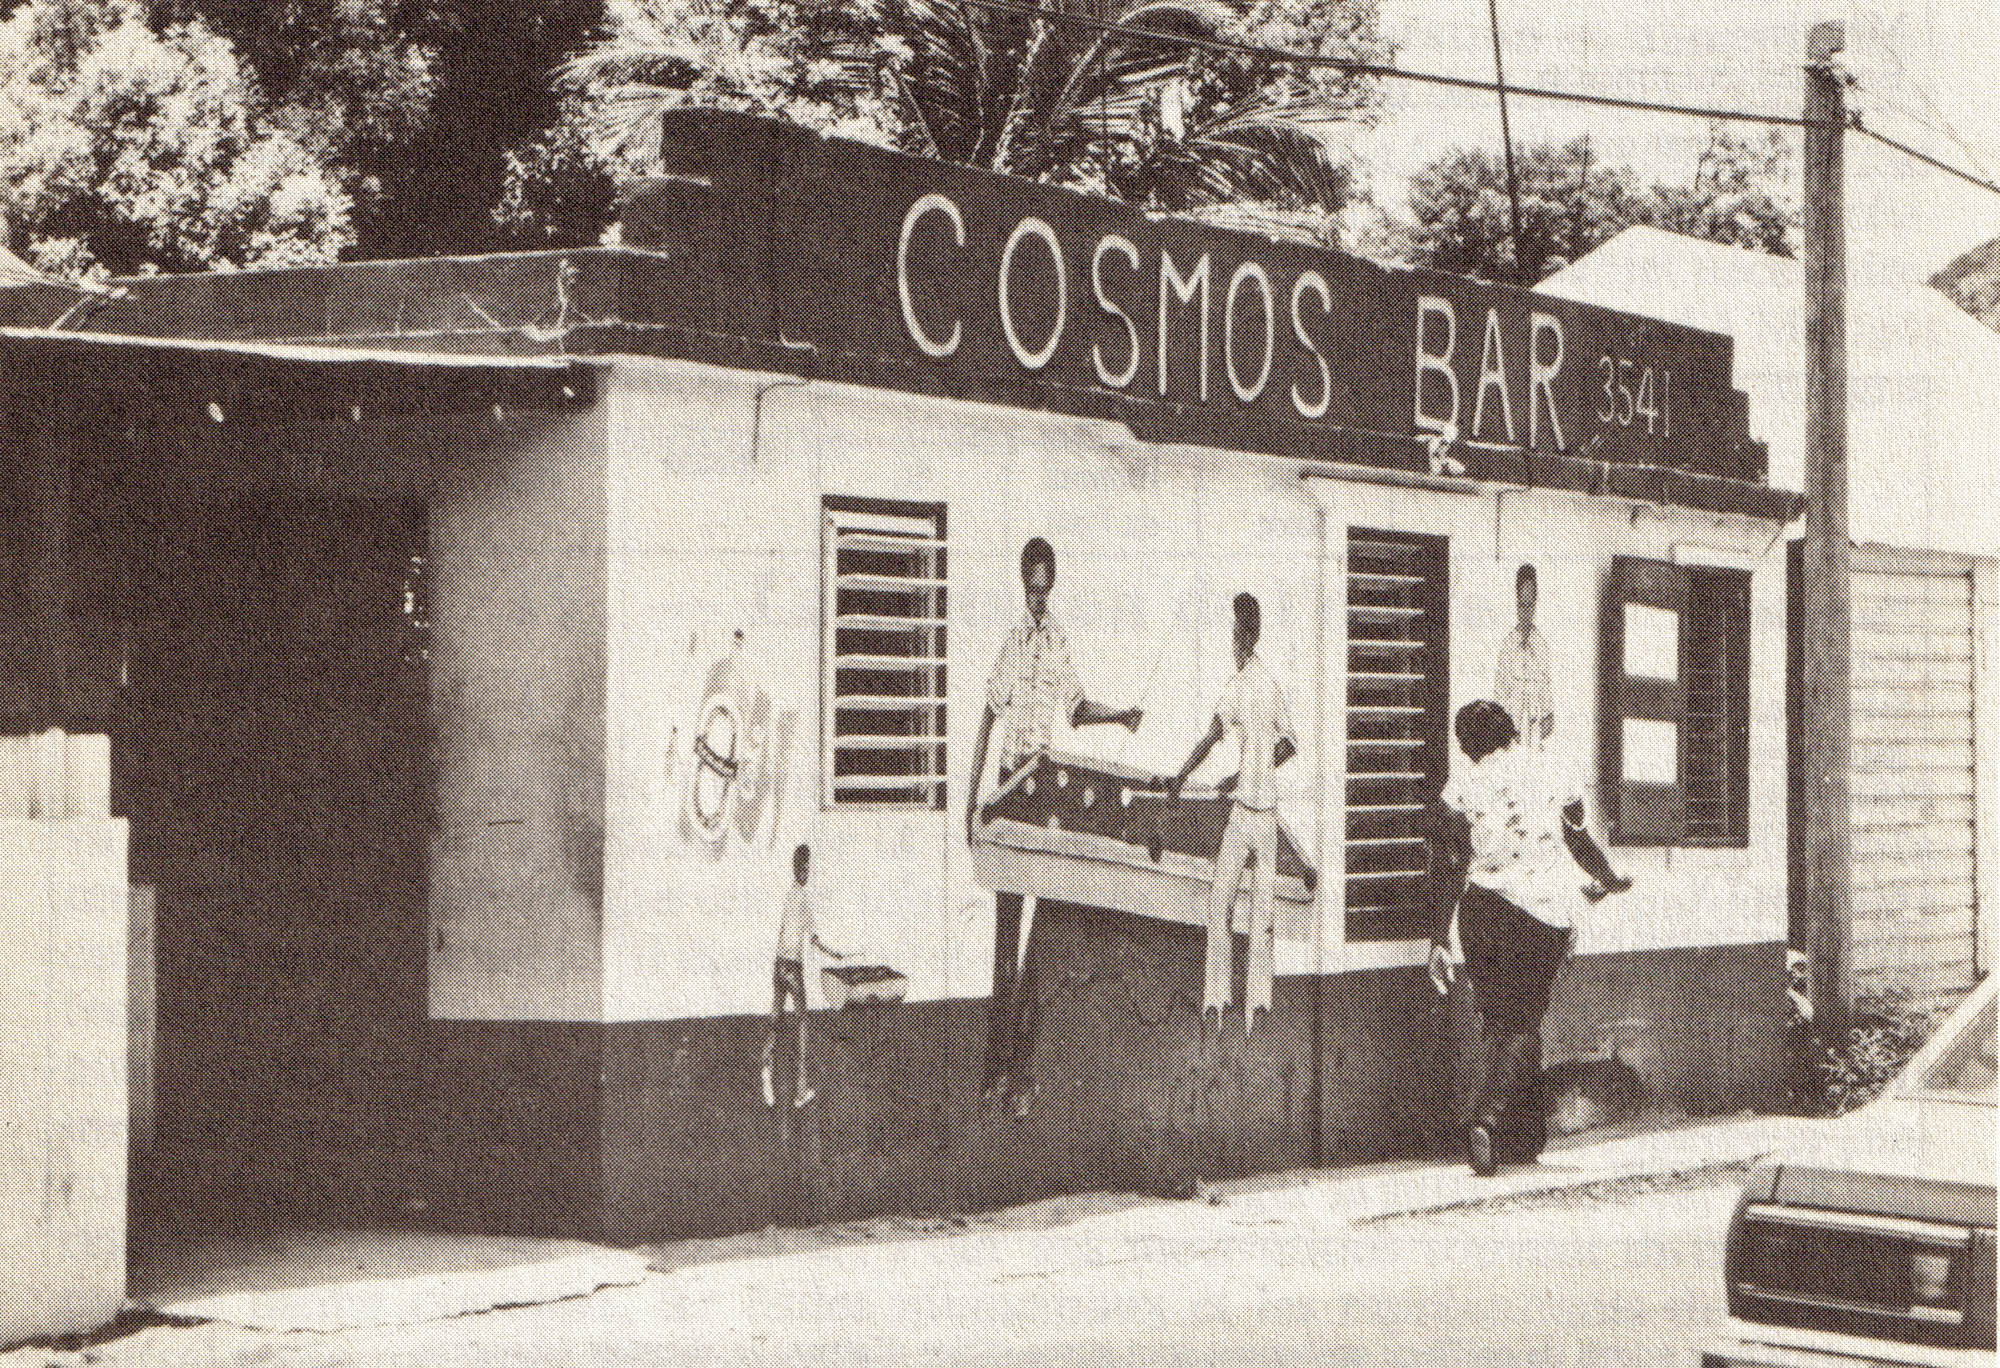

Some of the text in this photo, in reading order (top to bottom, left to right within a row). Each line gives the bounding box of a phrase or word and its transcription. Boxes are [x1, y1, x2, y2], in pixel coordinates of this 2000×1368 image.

[897, 193, 1669, 450] COSMOS BAR 3541
